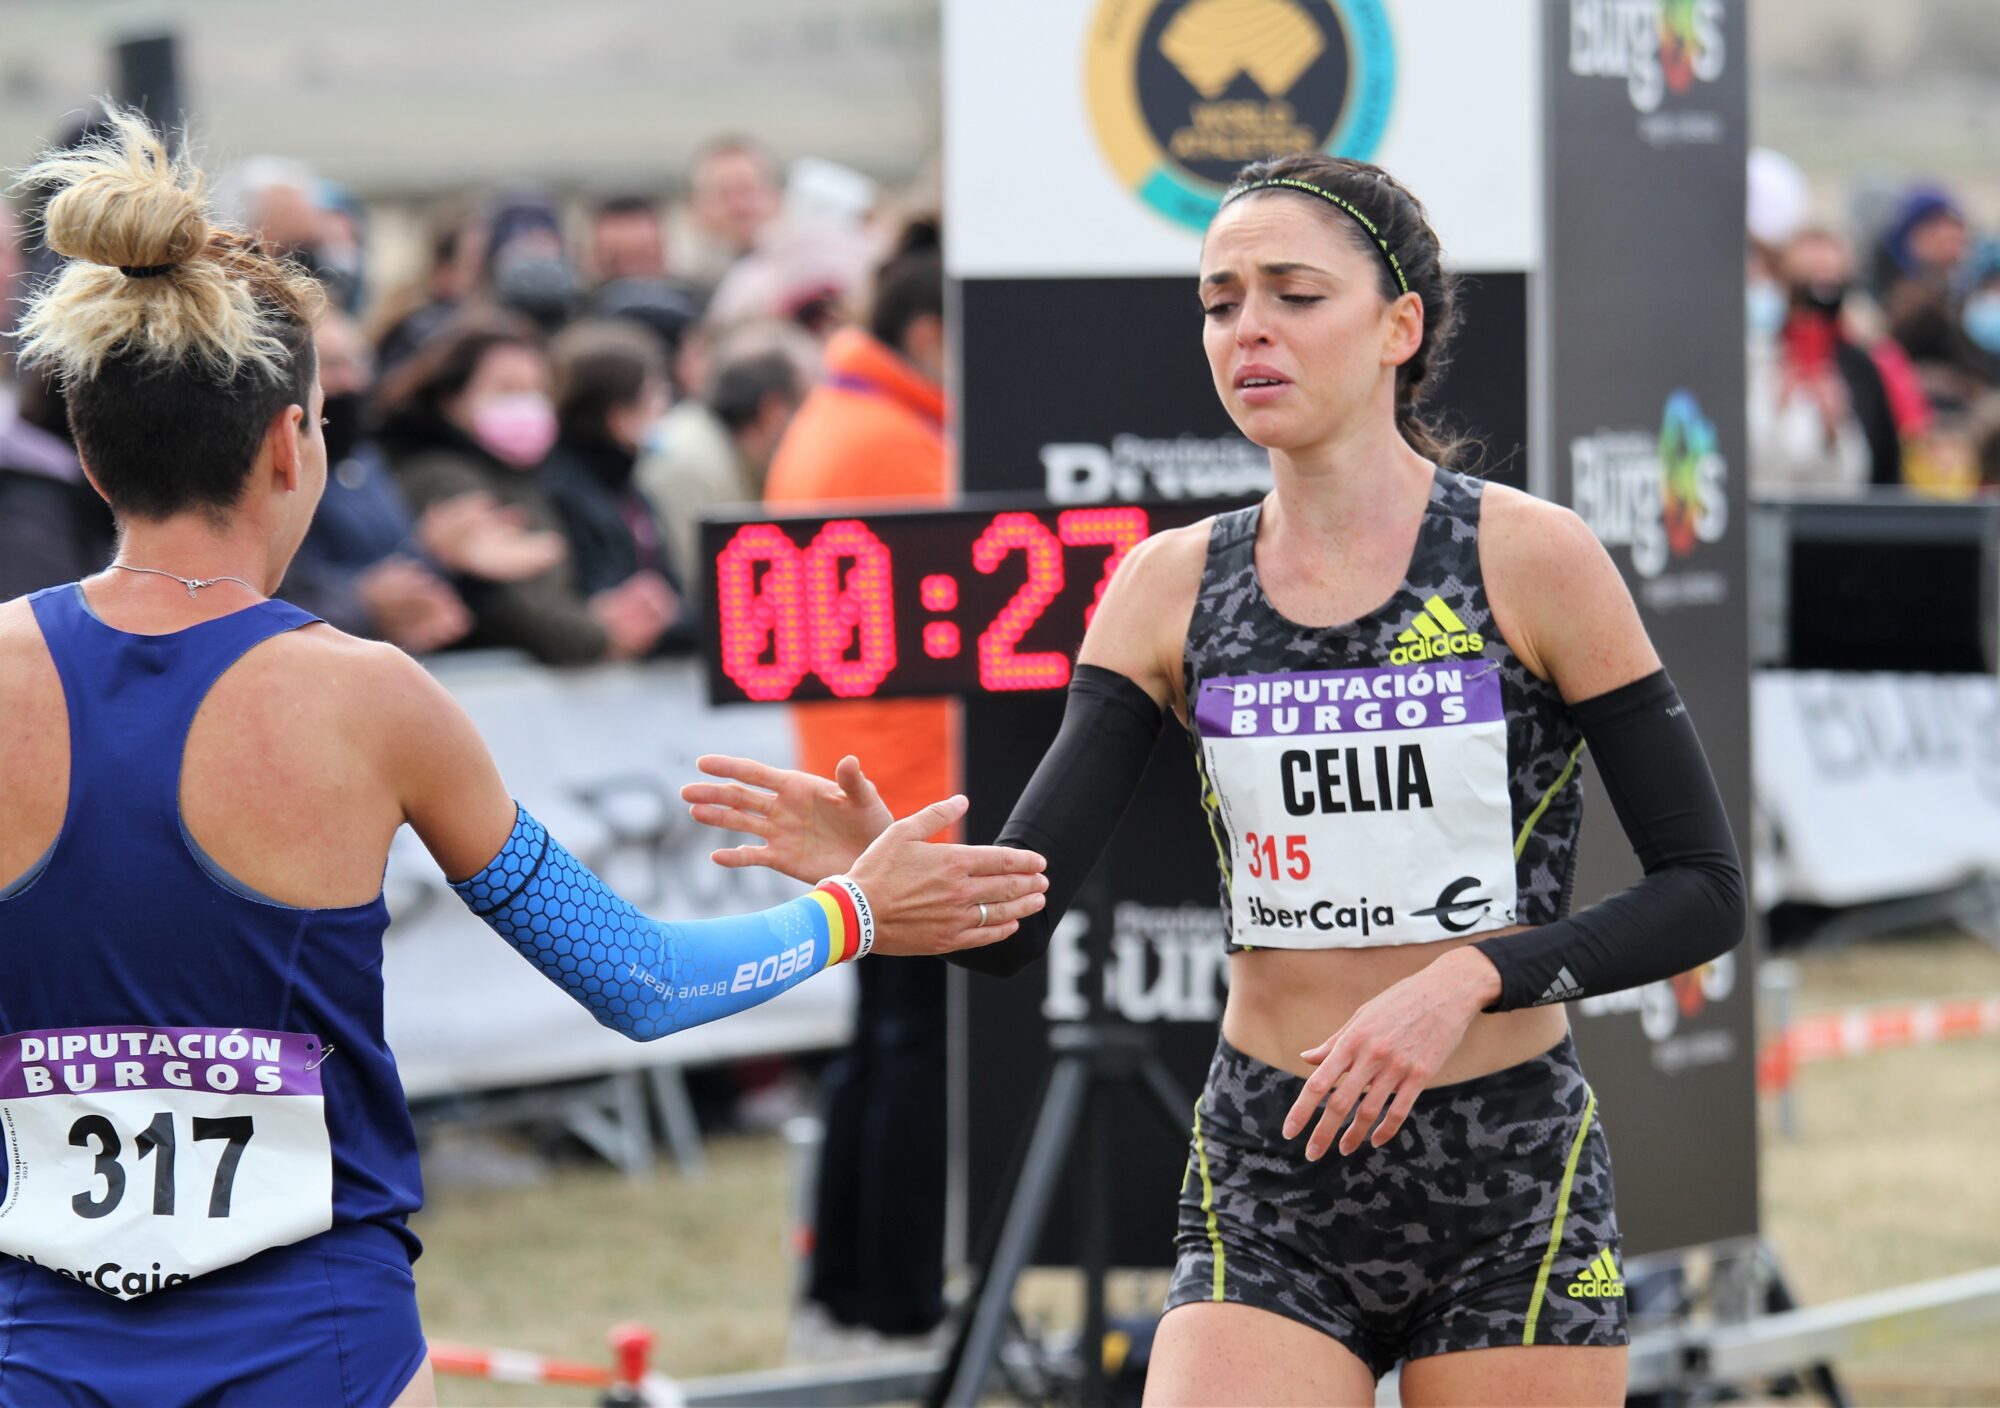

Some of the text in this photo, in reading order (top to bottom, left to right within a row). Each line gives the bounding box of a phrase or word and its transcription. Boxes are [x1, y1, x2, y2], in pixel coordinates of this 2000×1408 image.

[1266, 178, 1279, 186] LA
[1280, 178, 1321, 195] MARQUE
[1321, 189, 1341, 204] AUX
[1347, 204, 1378, 235] BANDES
[716, 506, 1150, 702] 00:27
[1389, 631, 1484, 666] adidas
[1232, 667, 1463, 707] DIPUTACIÓN
[1230, 695, 1467, 735] BURGOS
[1280, 743, 1434, 817] CELIA
[1245, 831, 1311, 881] 315
[844, 881, 870, 926] ALWAYS
[1247, 896, 1395, 937] iberCaja
[628, 962, 728, 1002] Brave Heart
[20, 1028, 282, 1063] DIPUTACIÓN
[22, 1061, 283, 1094] BURGOS
[68, 1111, 255, 1220] 317
[1567, 1278, 1625, 1298] adidas
